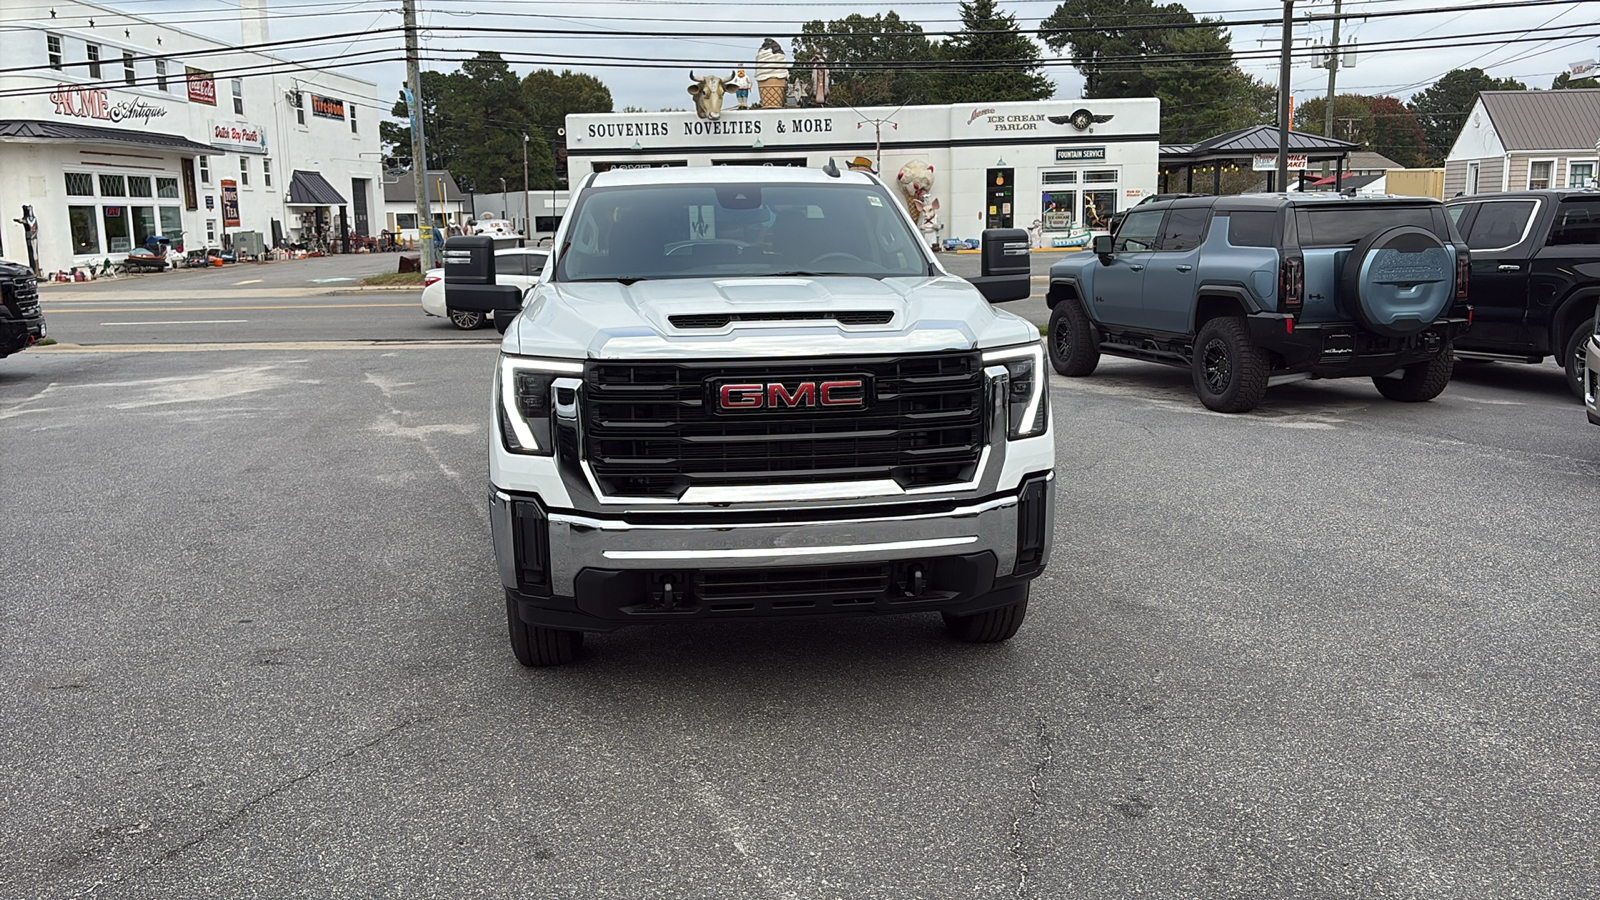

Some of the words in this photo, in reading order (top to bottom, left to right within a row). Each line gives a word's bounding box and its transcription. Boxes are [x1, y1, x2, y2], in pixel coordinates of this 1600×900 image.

[50, 83, 110, 120] ACME
[110, 95, 167, 125] Antiques
[312, 94, 344, 116] Firestone
[987, 115, 1004, 123] ICE
[1007, 114, 1045, 123] CREAM
[994, 123, 1037, 131] PARLOR
[214, 125, 230, 139] Dutch
[231, 127, 241, 143] Boy
[241, 129, 258, 142] Paints
[588, 121, 669, 138] SOUVENIRS
[684, 119, 762, 136] NOVELTIES
[776, 119, 786, 134] &
[792, 118, 832, 133] MORE
[1057, 150, 1082, 159] FOUNTAIN
[1083, 149, 1104, 158] SERVICE
[226, 206, 238, 218] TEA
[720, 380, 863, 408] GMC
